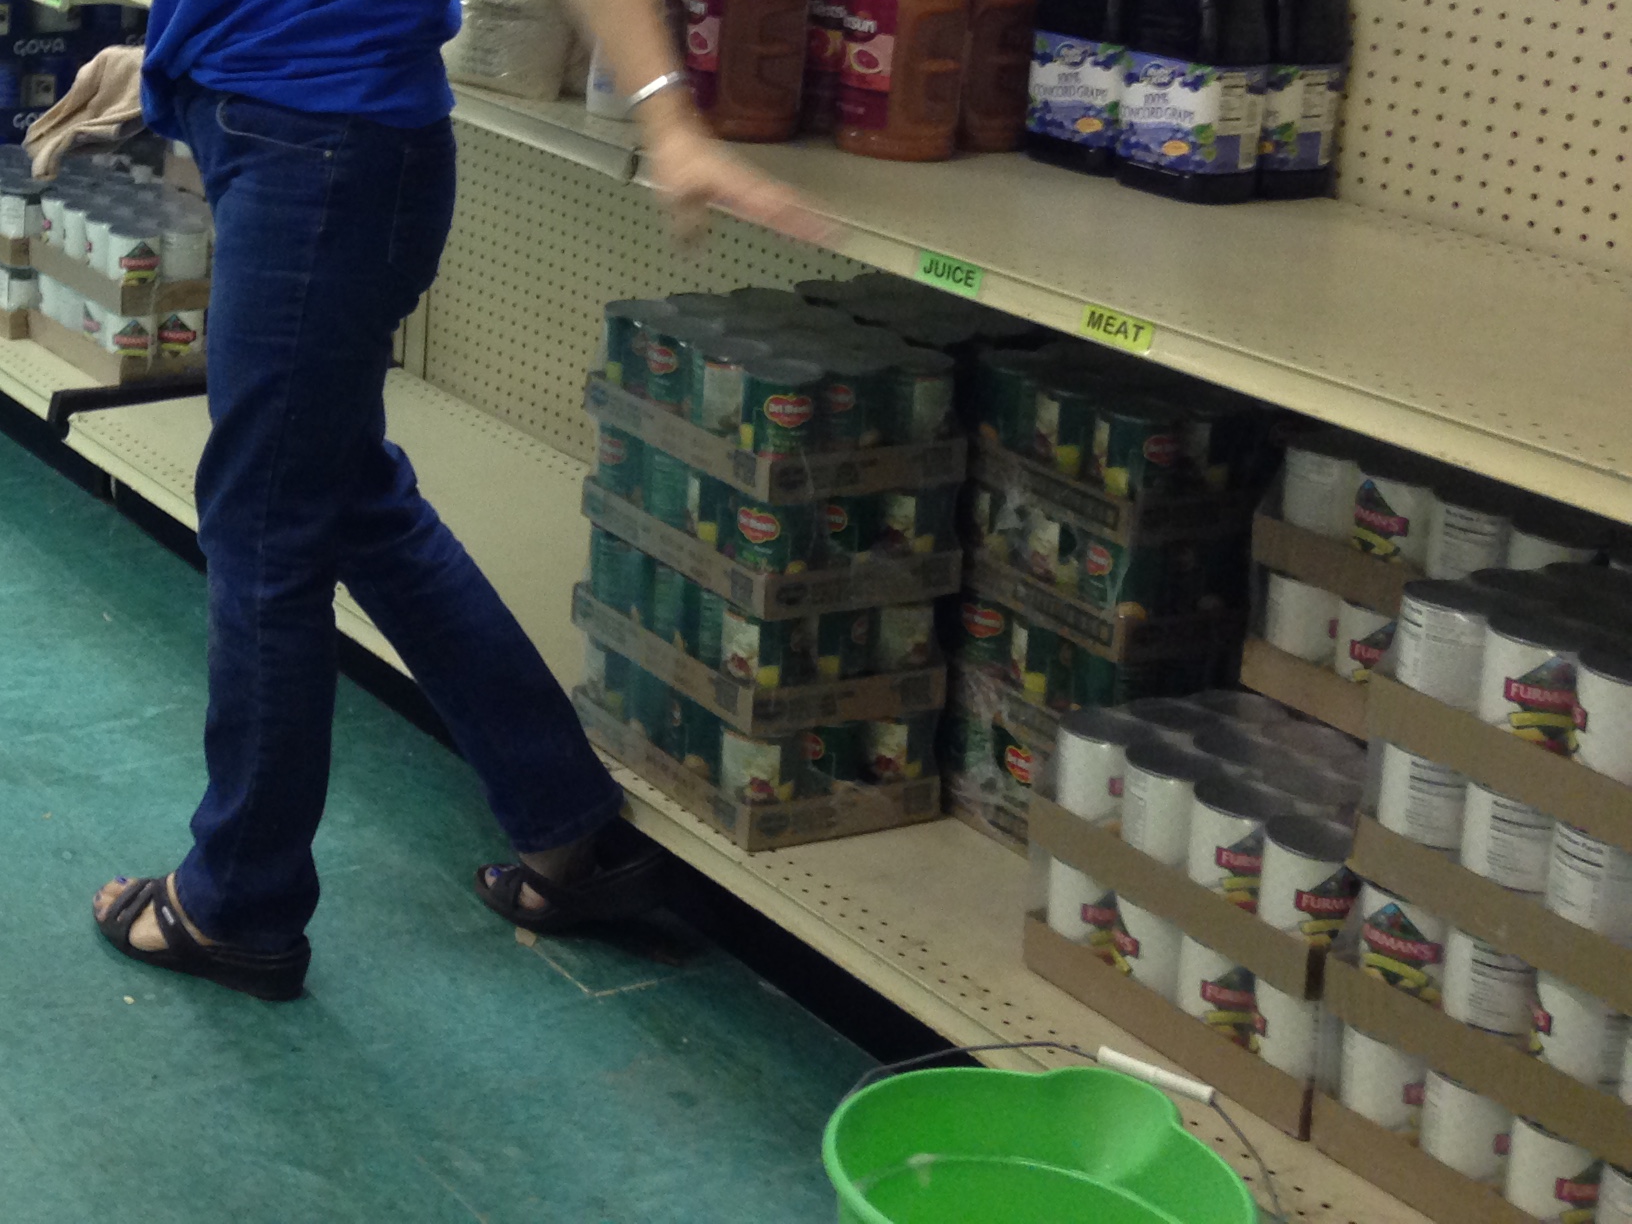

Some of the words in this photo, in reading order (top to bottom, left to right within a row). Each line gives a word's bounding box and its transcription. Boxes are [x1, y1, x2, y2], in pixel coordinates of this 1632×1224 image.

[12, 37, 66, 57] GOYA
[922, 259, 976, 289] JUICE
[1086, 310, 1145, 343] MEAT
